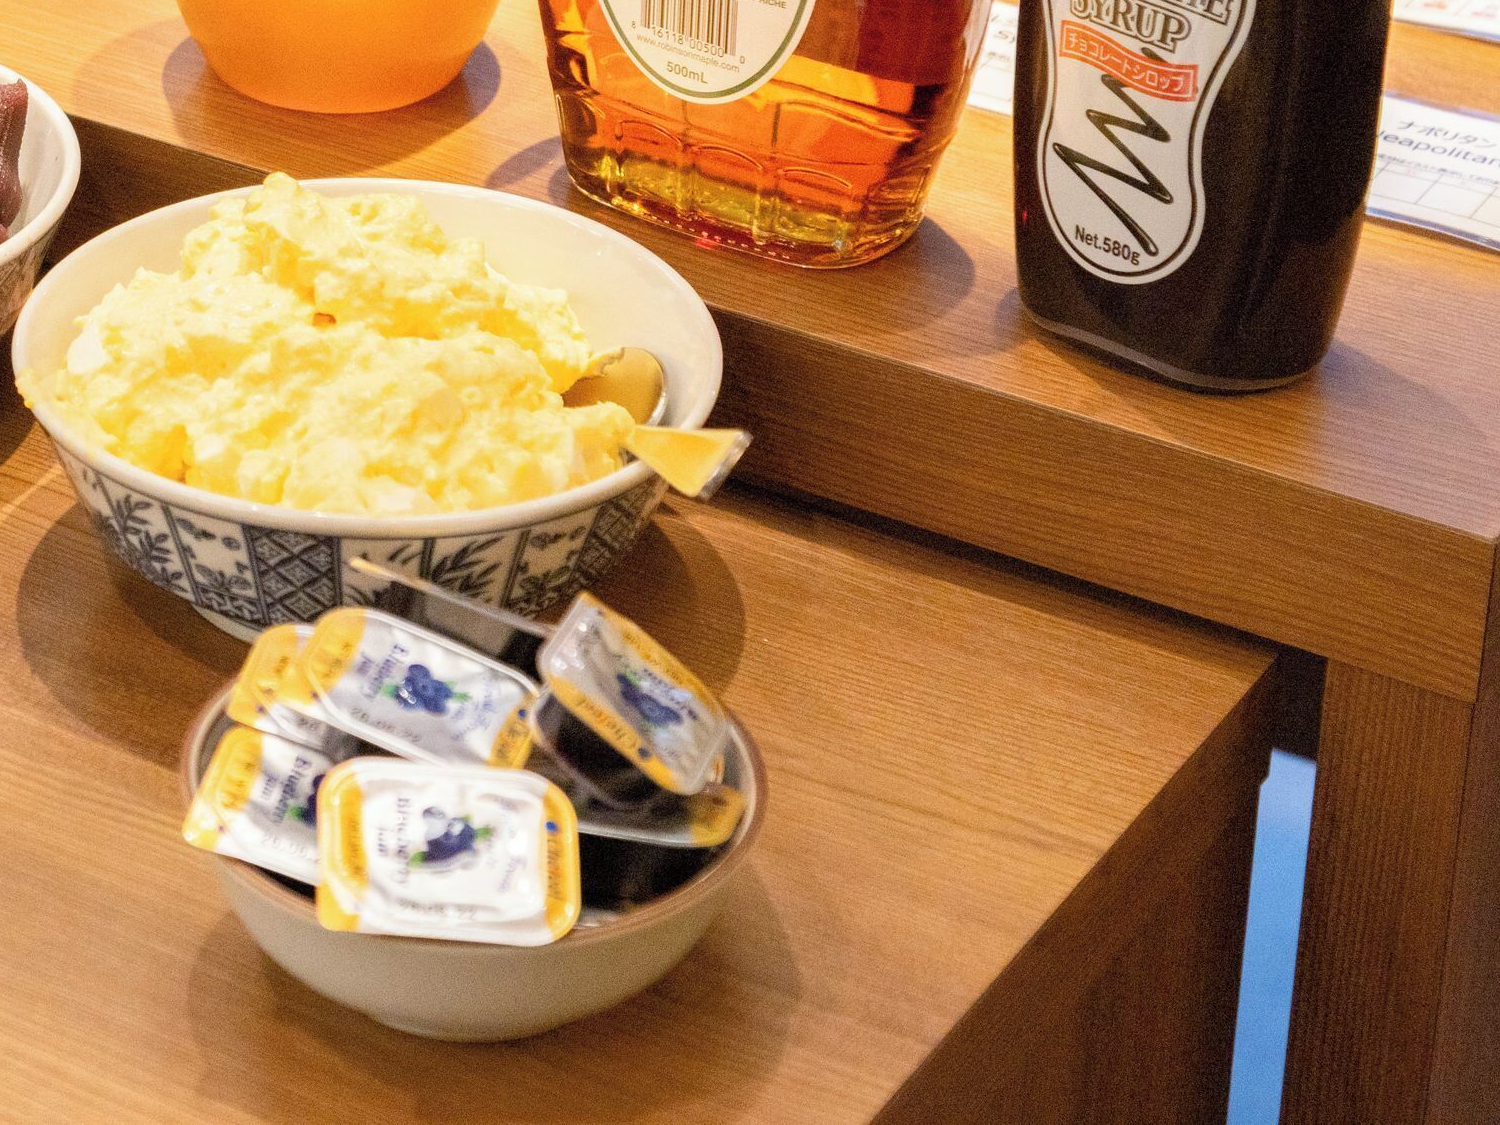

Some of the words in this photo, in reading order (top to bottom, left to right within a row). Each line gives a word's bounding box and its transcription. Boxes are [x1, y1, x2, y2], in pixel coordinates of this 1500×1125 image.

[637, 33, 741, 74] www.robinsonmaple.com
[652, 26, 684, 45] 16118
[689, 39, 725, 58] 00500
[740, 55, 746, 65] 0
[1068, 32, 1184, 92] チョコレートシロップ
[667, 61, 708, 84] 500mL
[1075, 224, 1140, 266] Net.580g
